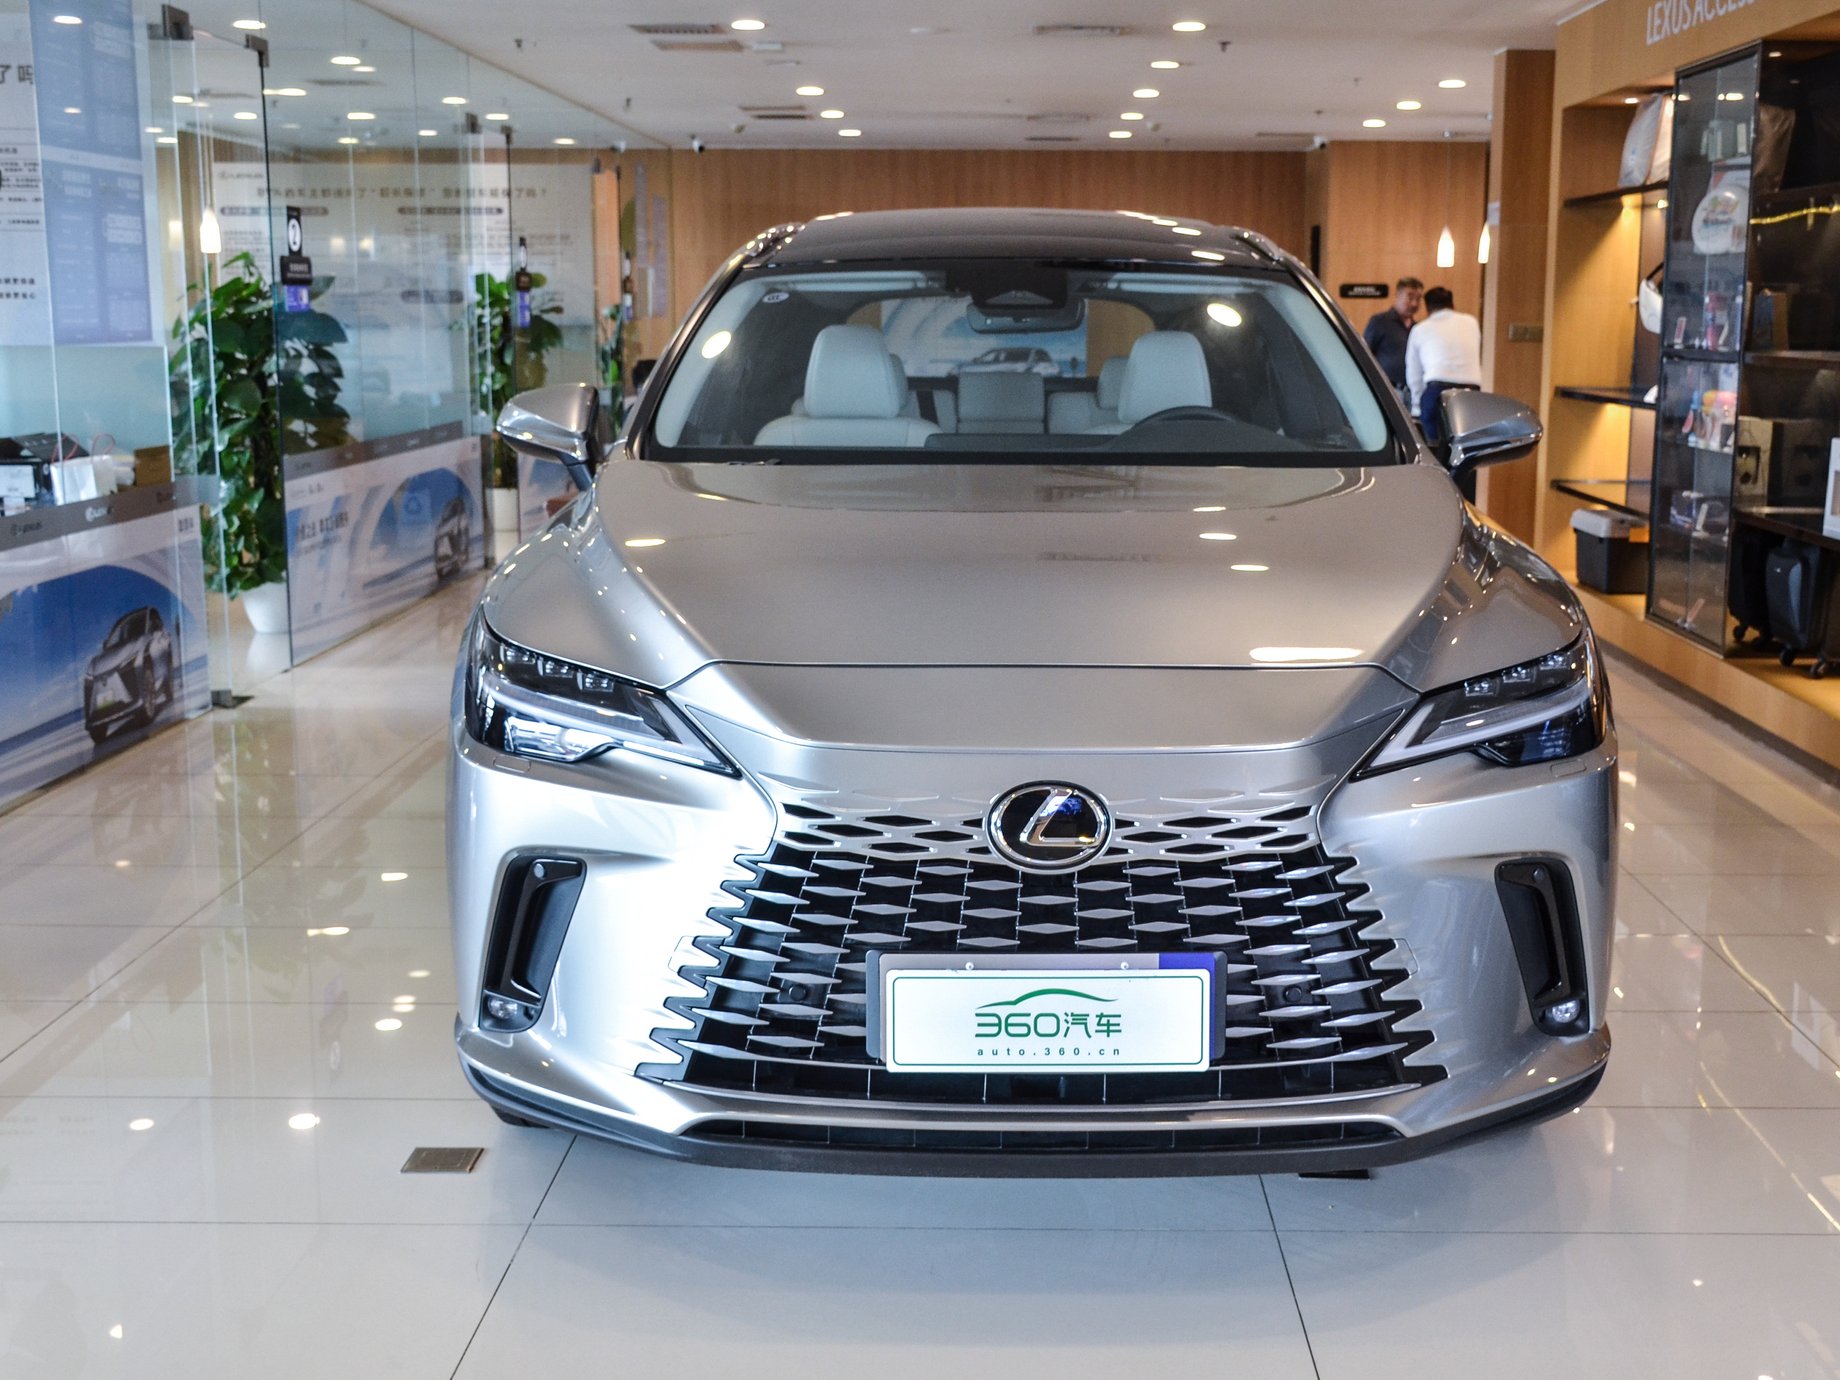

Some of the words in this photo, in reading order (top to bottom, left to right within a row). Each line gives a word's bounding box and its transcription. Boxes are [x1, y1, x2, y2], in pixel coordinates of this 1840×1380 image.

[1646, 0, 1692, 46] LEXUS
[974, 1011, 1123, 1039] 360汽车
[976, 1047, 1121, 1056] auto.360.cn
